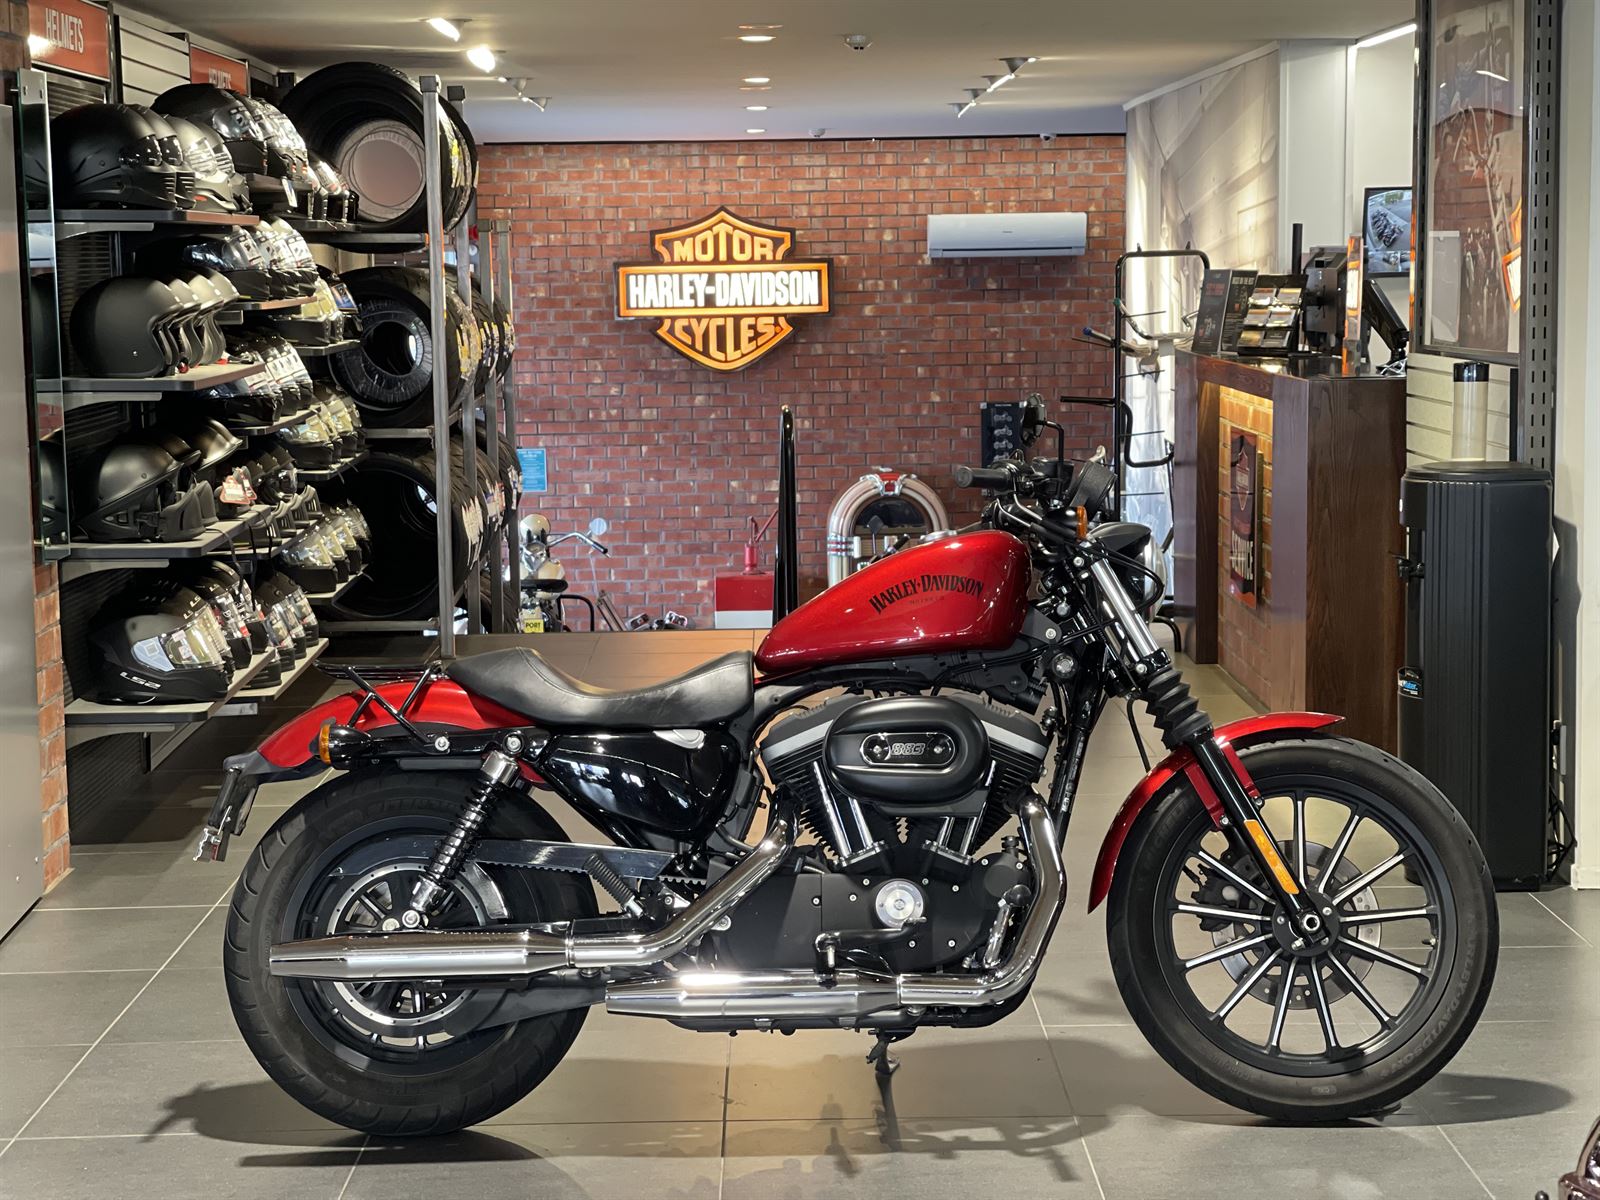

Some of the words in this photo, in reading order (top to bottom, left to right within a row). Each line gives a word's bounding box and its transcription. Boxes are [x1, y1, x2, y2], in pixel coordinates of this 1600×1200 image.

[45, 7, 84, 54] HELMETS
[673, 222, 774, 262] MOTOR
[628, 270, 819, 309] HARLEY-DAVIDSON
[673, 316, 776, 362] CYCLES
[120, 672, 161, 689] LS2
[891, 742, 926, 755] 883
